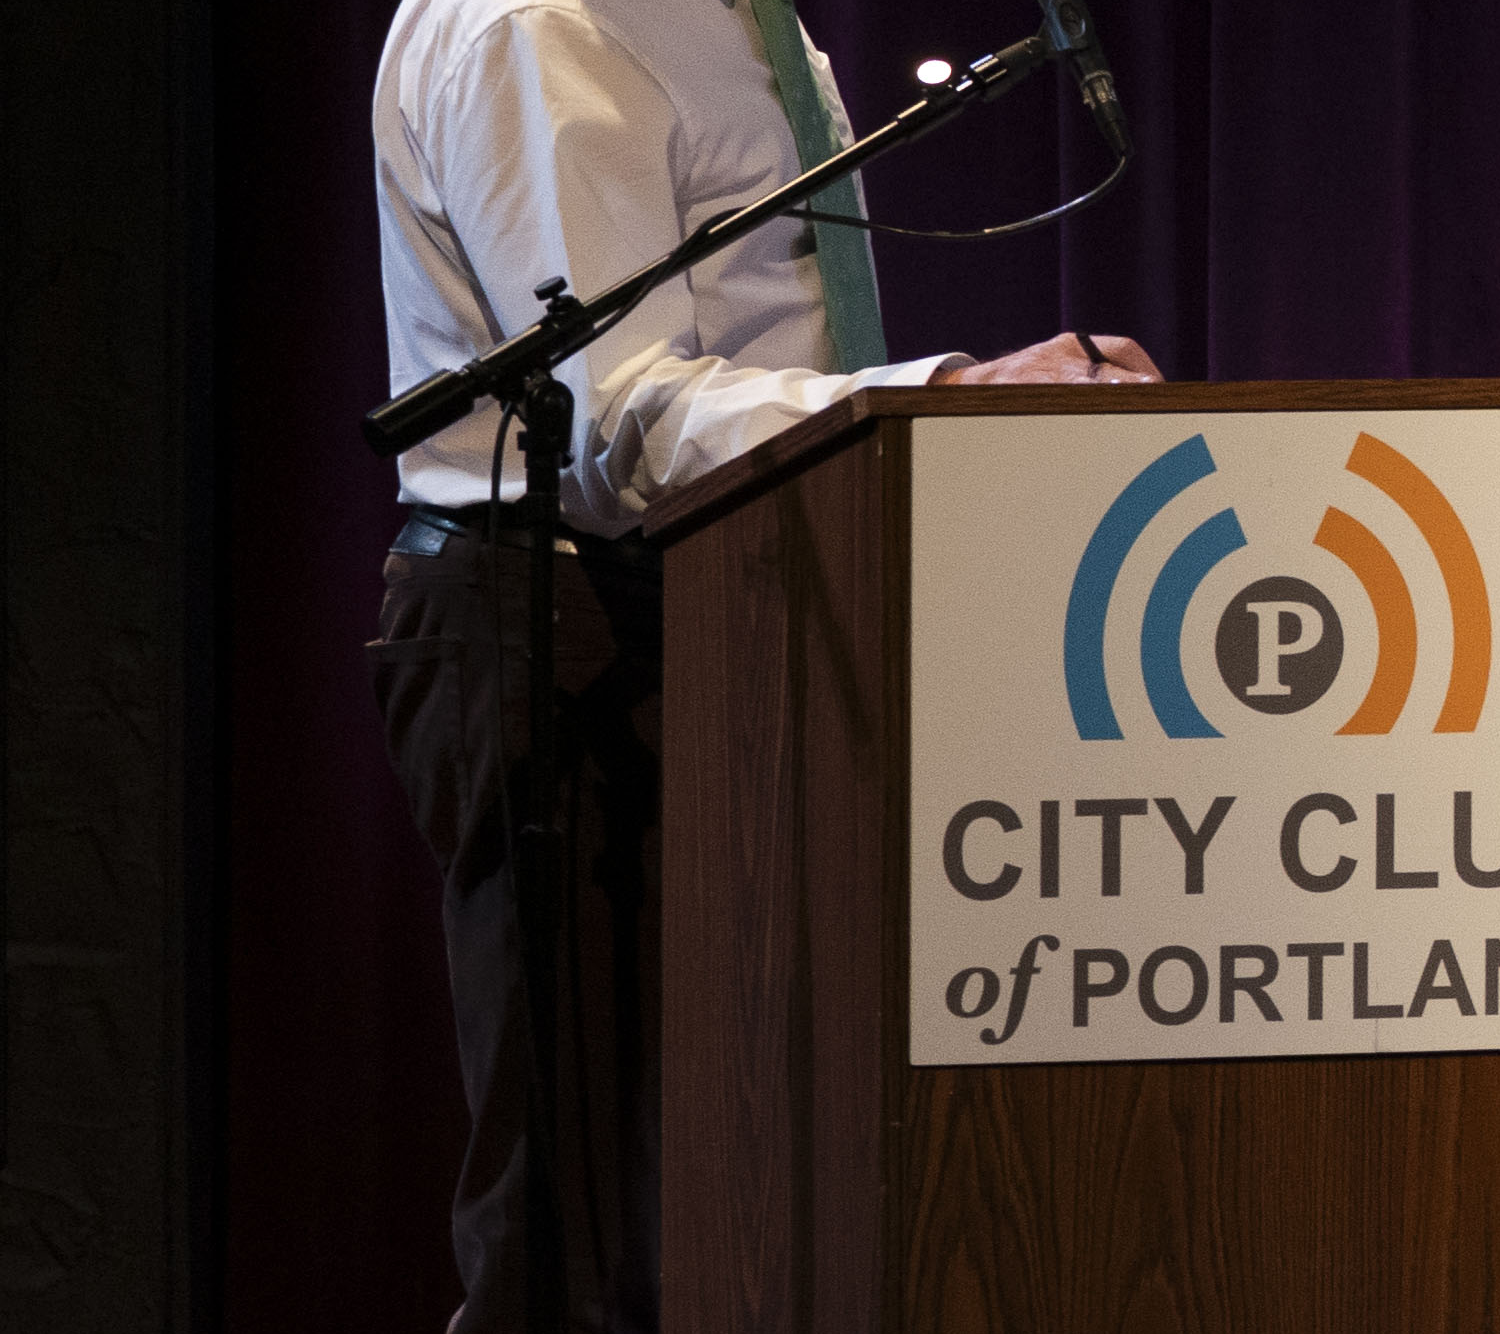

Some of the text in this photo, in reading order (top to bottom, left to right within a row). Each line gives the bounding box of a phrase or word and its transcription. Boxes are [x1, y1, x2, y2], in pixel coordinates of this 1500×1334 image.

[1246, 600, 1325, 697] P
[942, 796, 1237, 902] CITY
[944, 934, 1061, 1046] of
